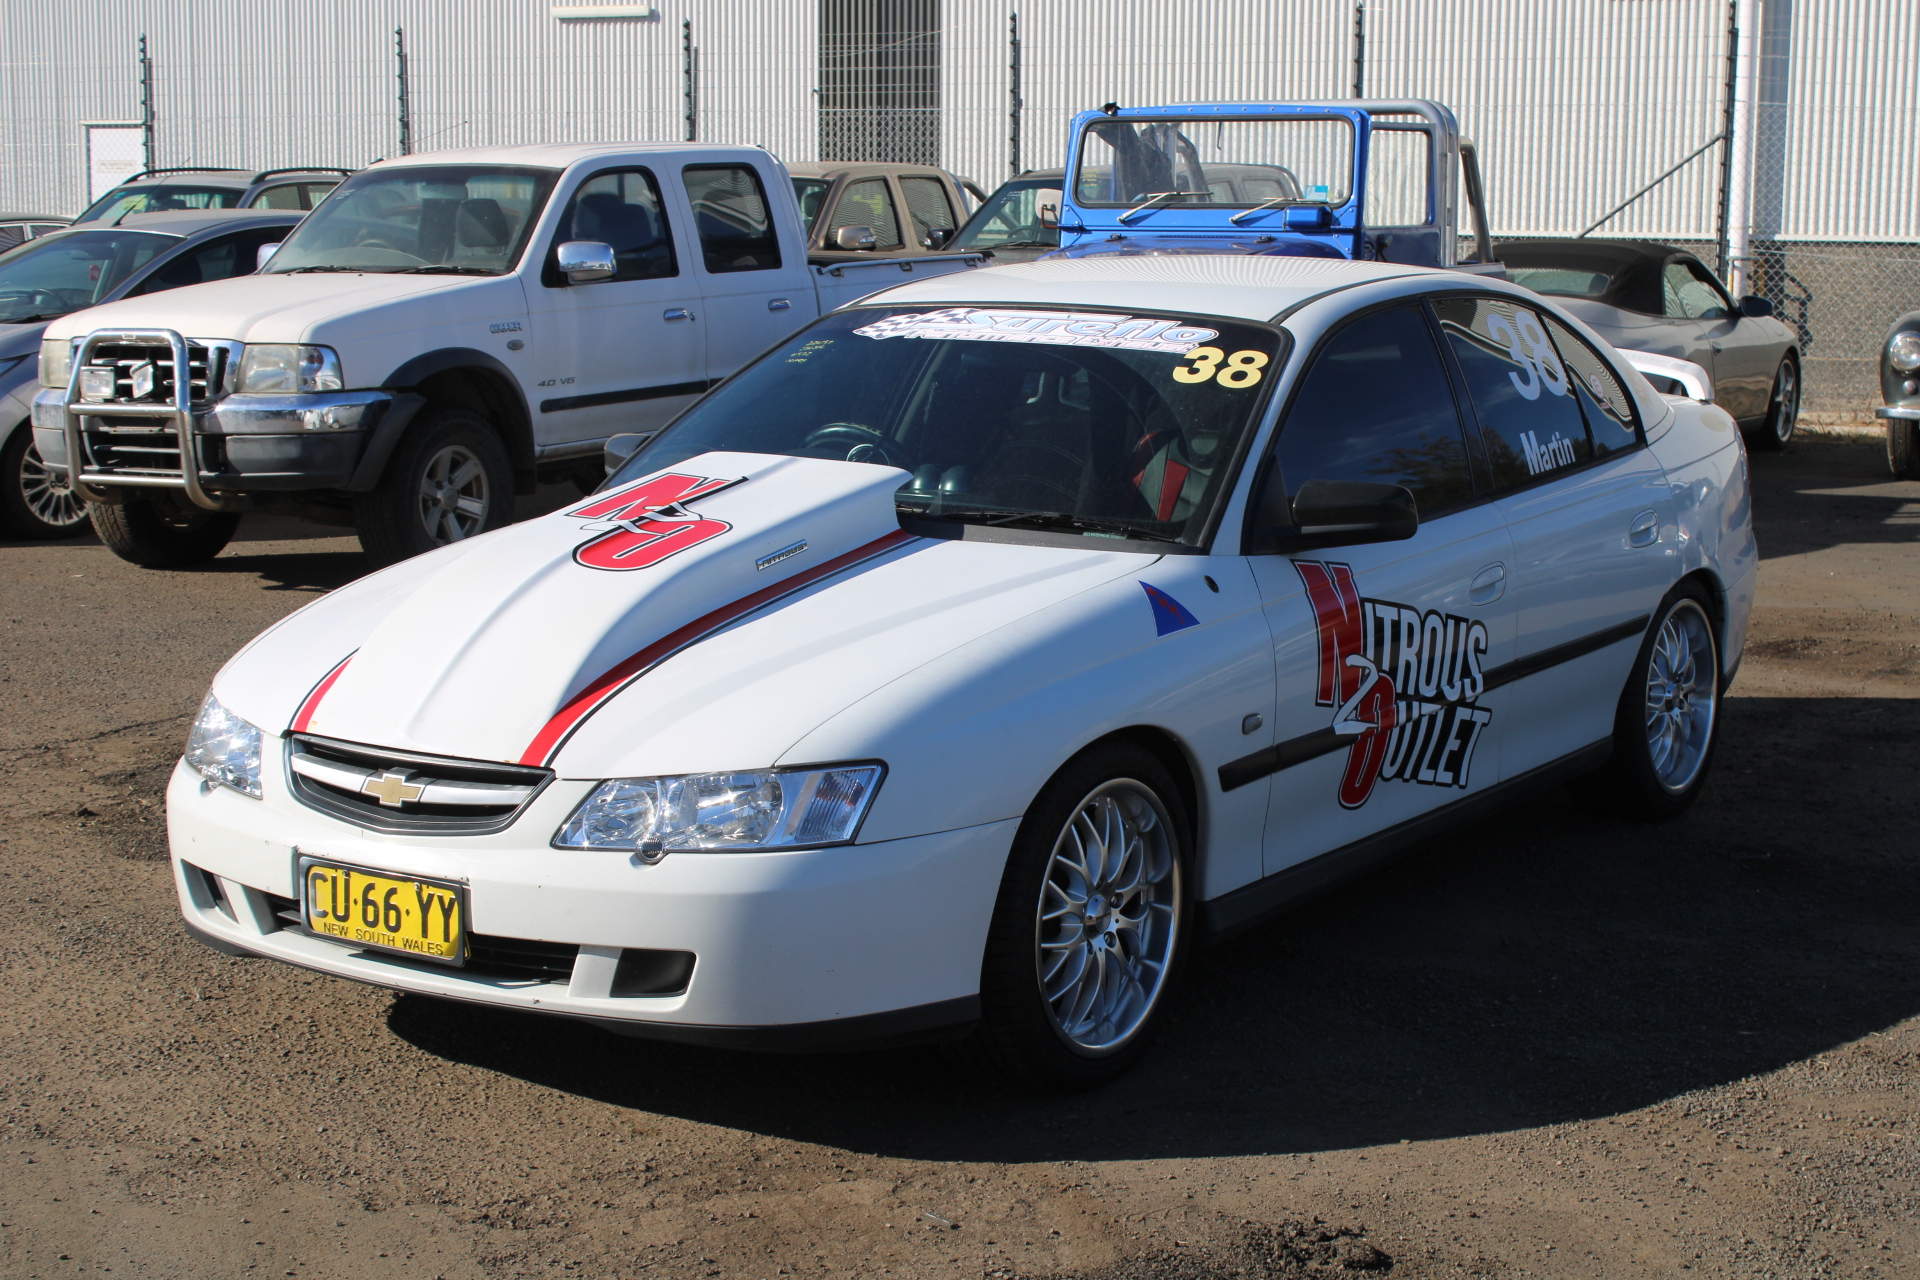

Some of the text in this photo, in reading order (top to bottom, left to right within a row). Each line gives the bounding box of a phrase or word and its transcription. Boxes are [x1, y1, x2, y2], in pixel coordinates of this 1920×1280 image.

[908, 309, 1219, 343] Sureflo
[1173, 347, 1268, 388] 38
[1487, 311, 1568, 400] 38
[560, 377, 576, 385] V6
[1520, 430, 1576, 476] Martin
[1290, 558, 1489, 709] NITROUS
[1337, 669, 1493, 811] OUTLET
[323, 921, 444, 956] NEW SOUTH WALES
